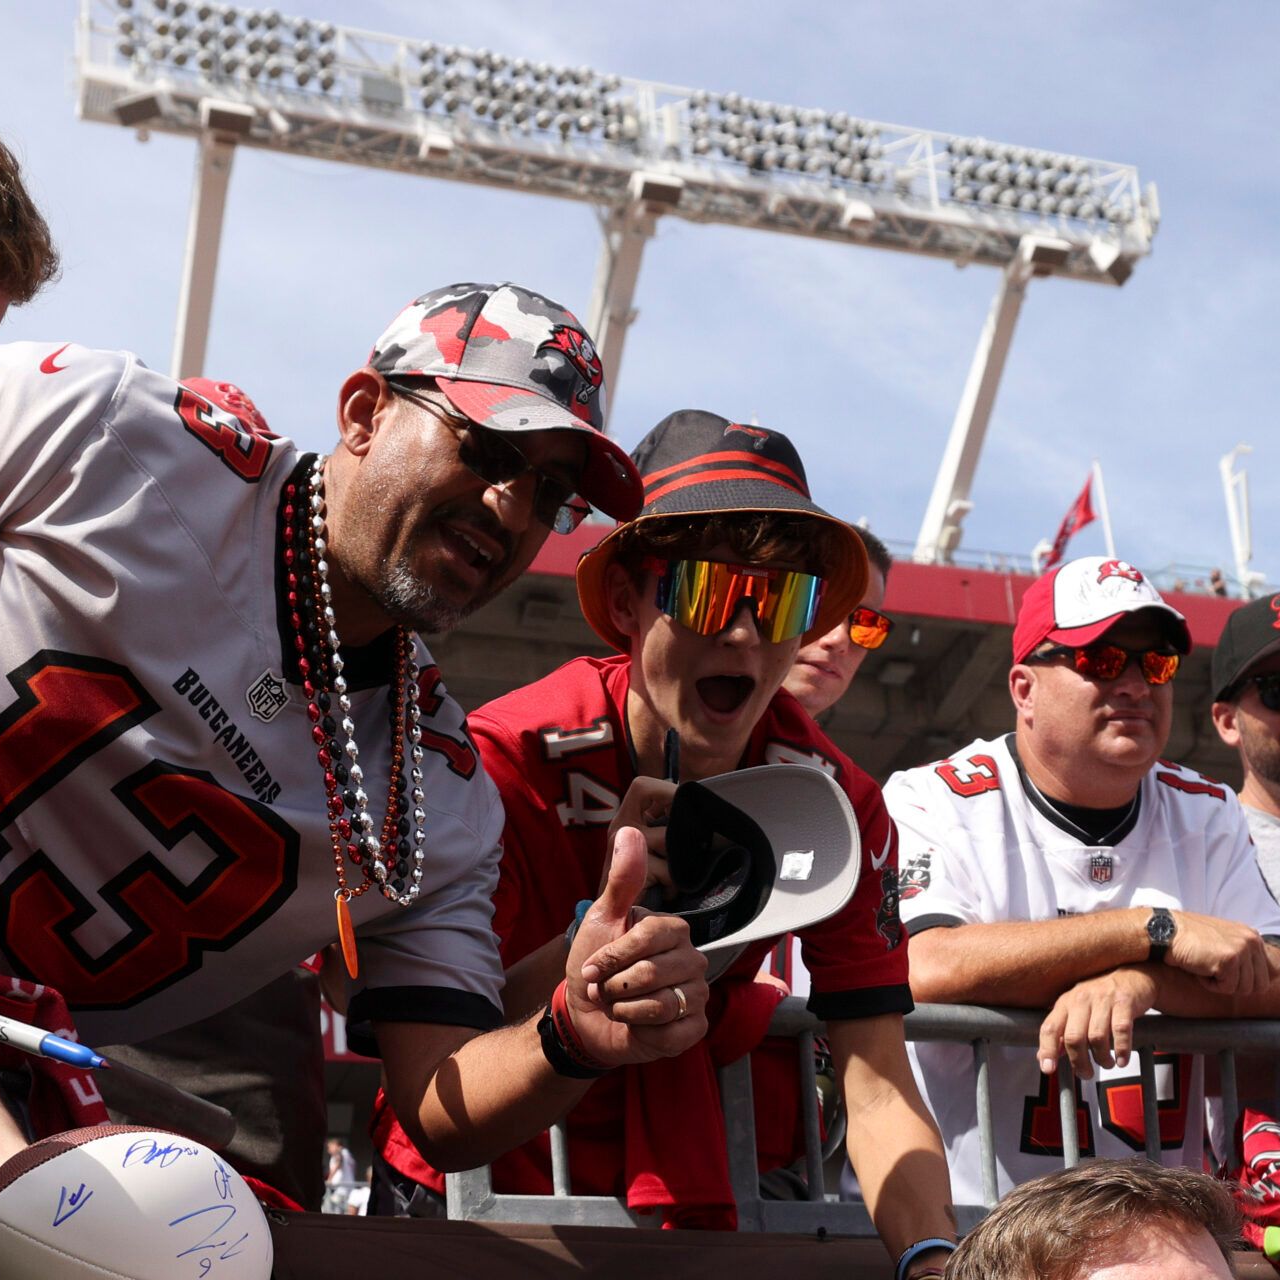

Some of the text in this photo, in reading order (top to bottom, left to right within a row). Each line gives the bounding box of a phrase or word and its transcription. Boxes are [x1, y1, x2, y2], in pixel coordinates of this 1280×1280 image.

[172, 666, 282, 804] BUCCANEERS
[253, 687, 277, 716] NFL
[538, 716, 621, 828] 14
[1092, 867, 1112, 885] NFL
